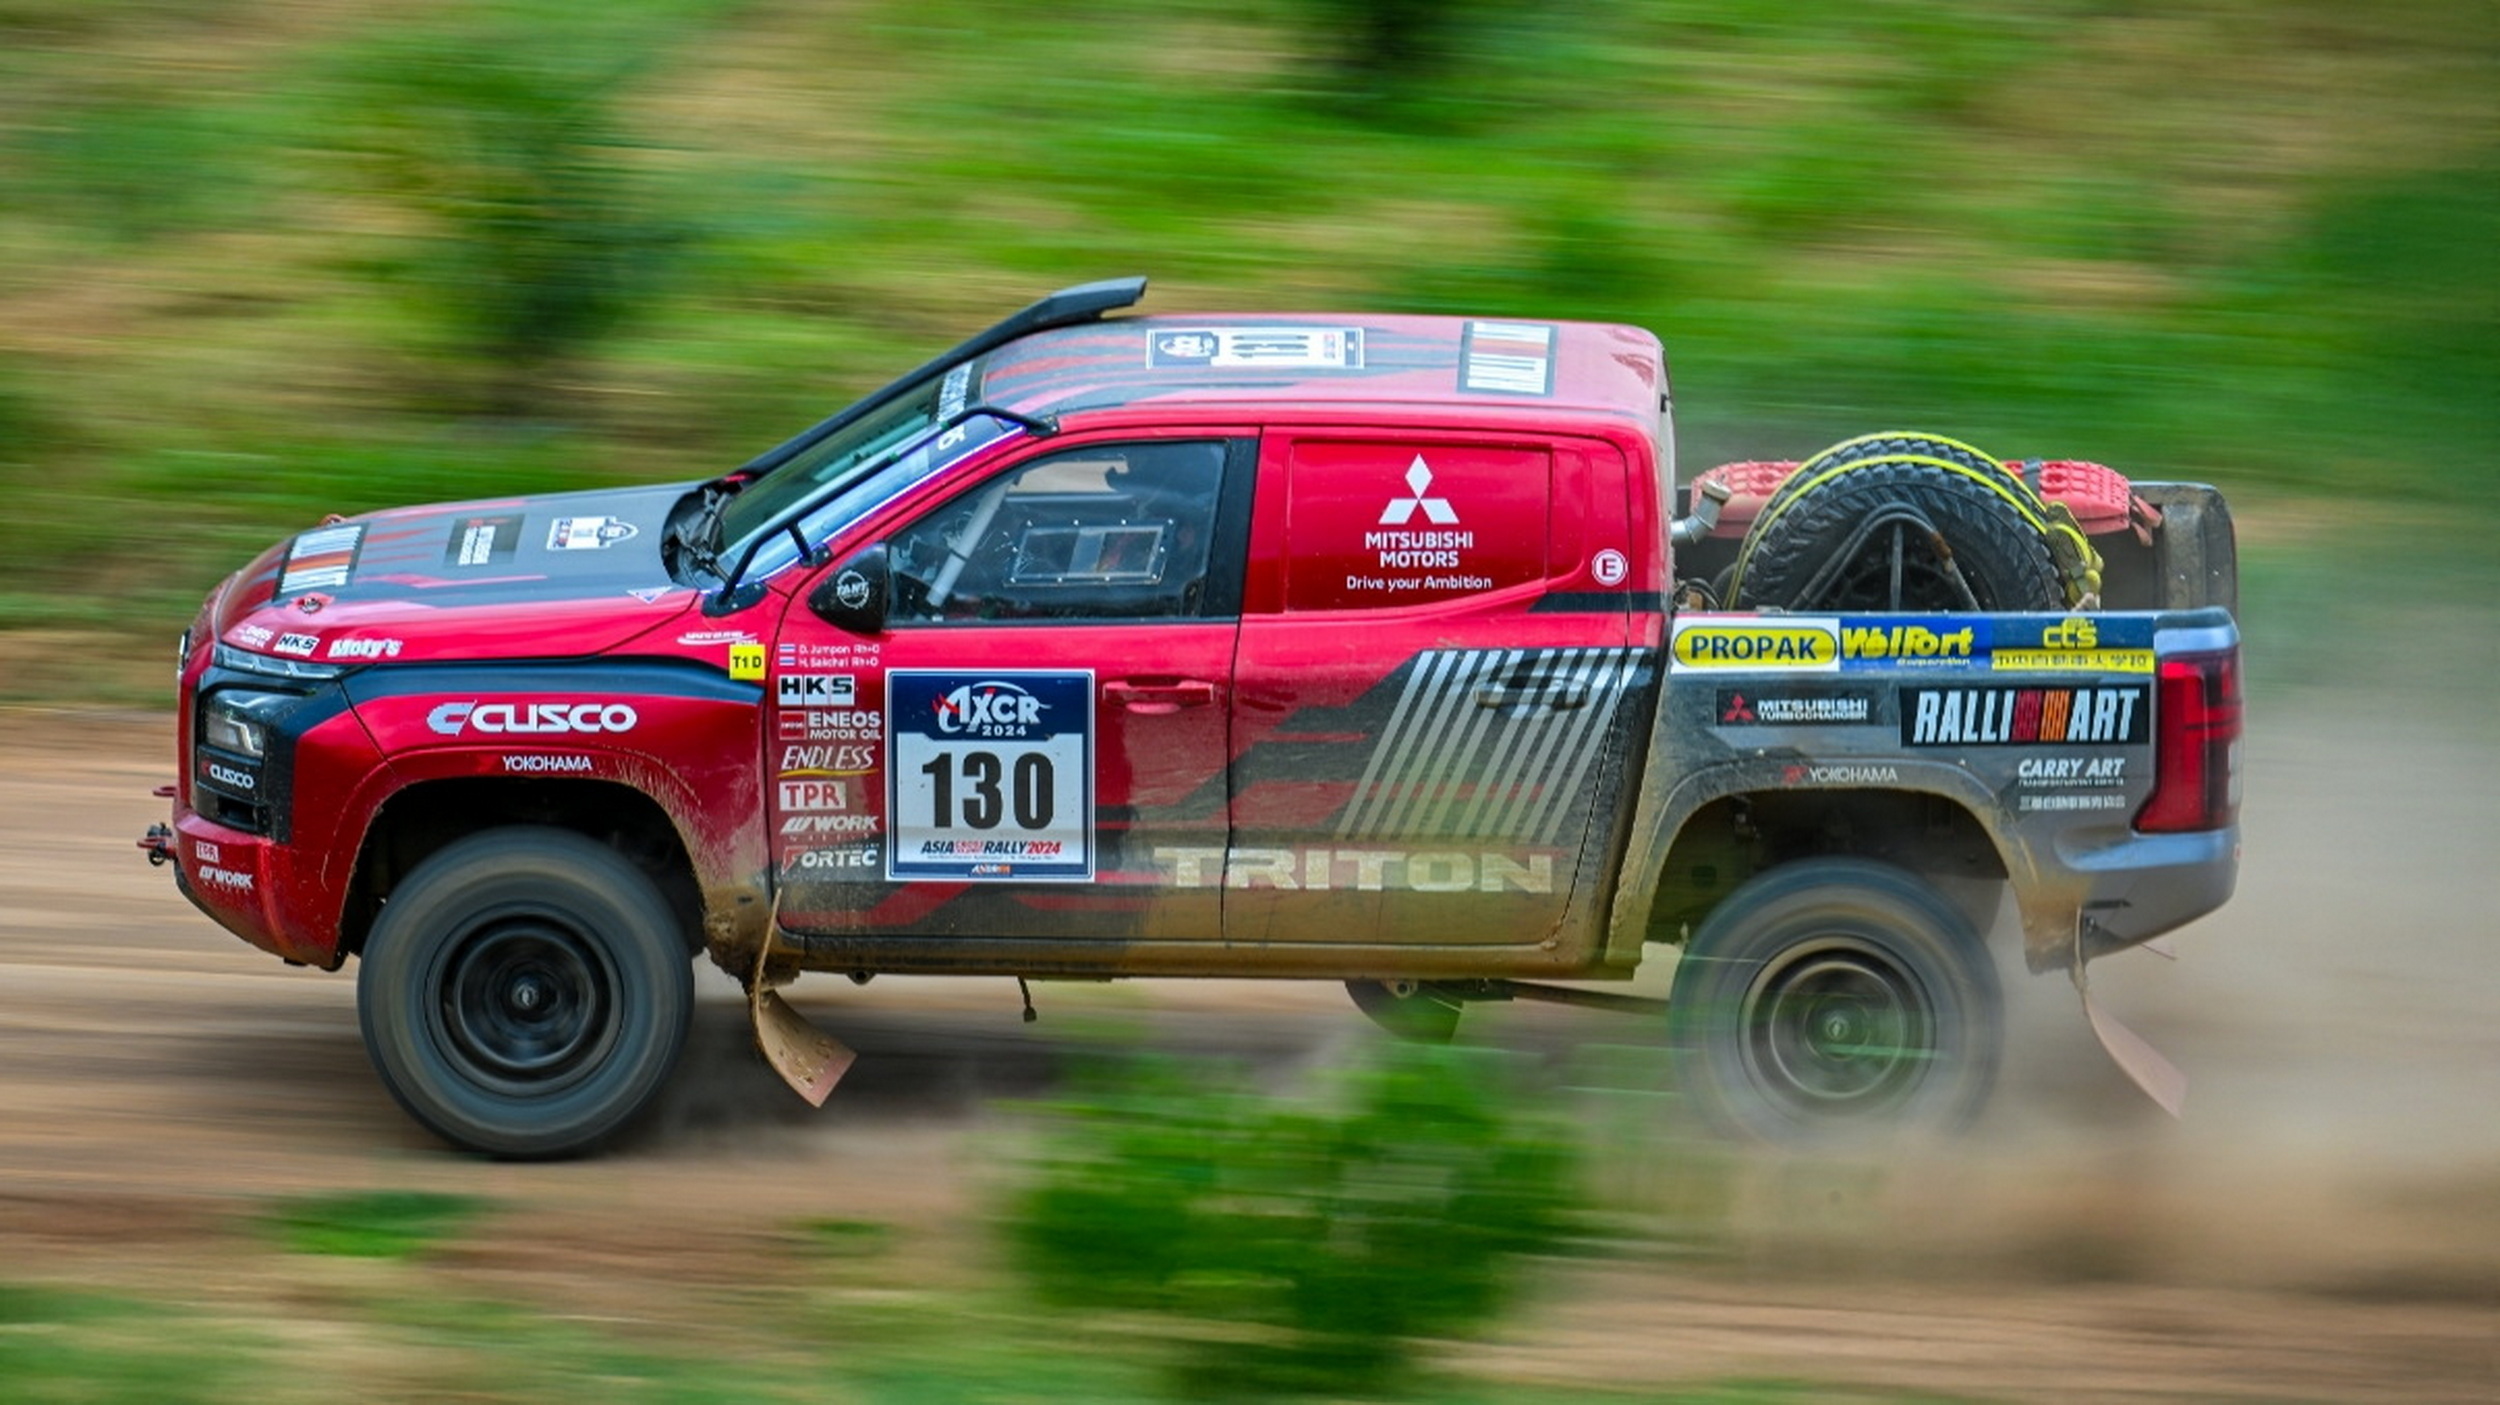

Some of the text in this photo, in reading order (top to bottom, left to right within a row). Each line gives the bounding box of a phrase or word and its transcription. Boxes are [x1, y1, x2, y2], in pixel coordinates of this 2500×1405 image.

[1365, 531, 1474, 549] MITSUBISHI
[1379, 550, 1459, 568] MOTORS
[1603, 558, 1617, 577] E
[1346, 575, 1492, 593] Drive your Ambition
[279, 633, 318, 650] HKS
[1691, 635, 1816, 660] PROPAK
[781, 677, 853, 695] HKS
[1757, 700, 1868, 713] MITSUBISHI
[471, 703, 638, 734] CUSCO
[808, 711, 881, 728] ENEOS
[809, 729, 882, 740] MOTOR OIL
[981, 724, 1027, 737] 2024
[502, 755, 592, 771] YOKOHAMA
[781, 745, 876, 770] ENDLESS
[209, 763, 254, 789] CUSCO
[1809, 766, 1899, 781] YOKOHAMA
[2018, 757, 2126, 778] CARRY ART
[785, 785, 840, 807] TPR
[922, 751, 1055, 830] 130
[814, 815, 879, 833] WORK
[920, 839, 954, 855] ASIA
[983, 839, 1027, 855] RALLY
[1026, 839, 1062, 855] 2024
[215, 868, 254, 889] WORK
[1153, 846, 1553, 893] TRITON
